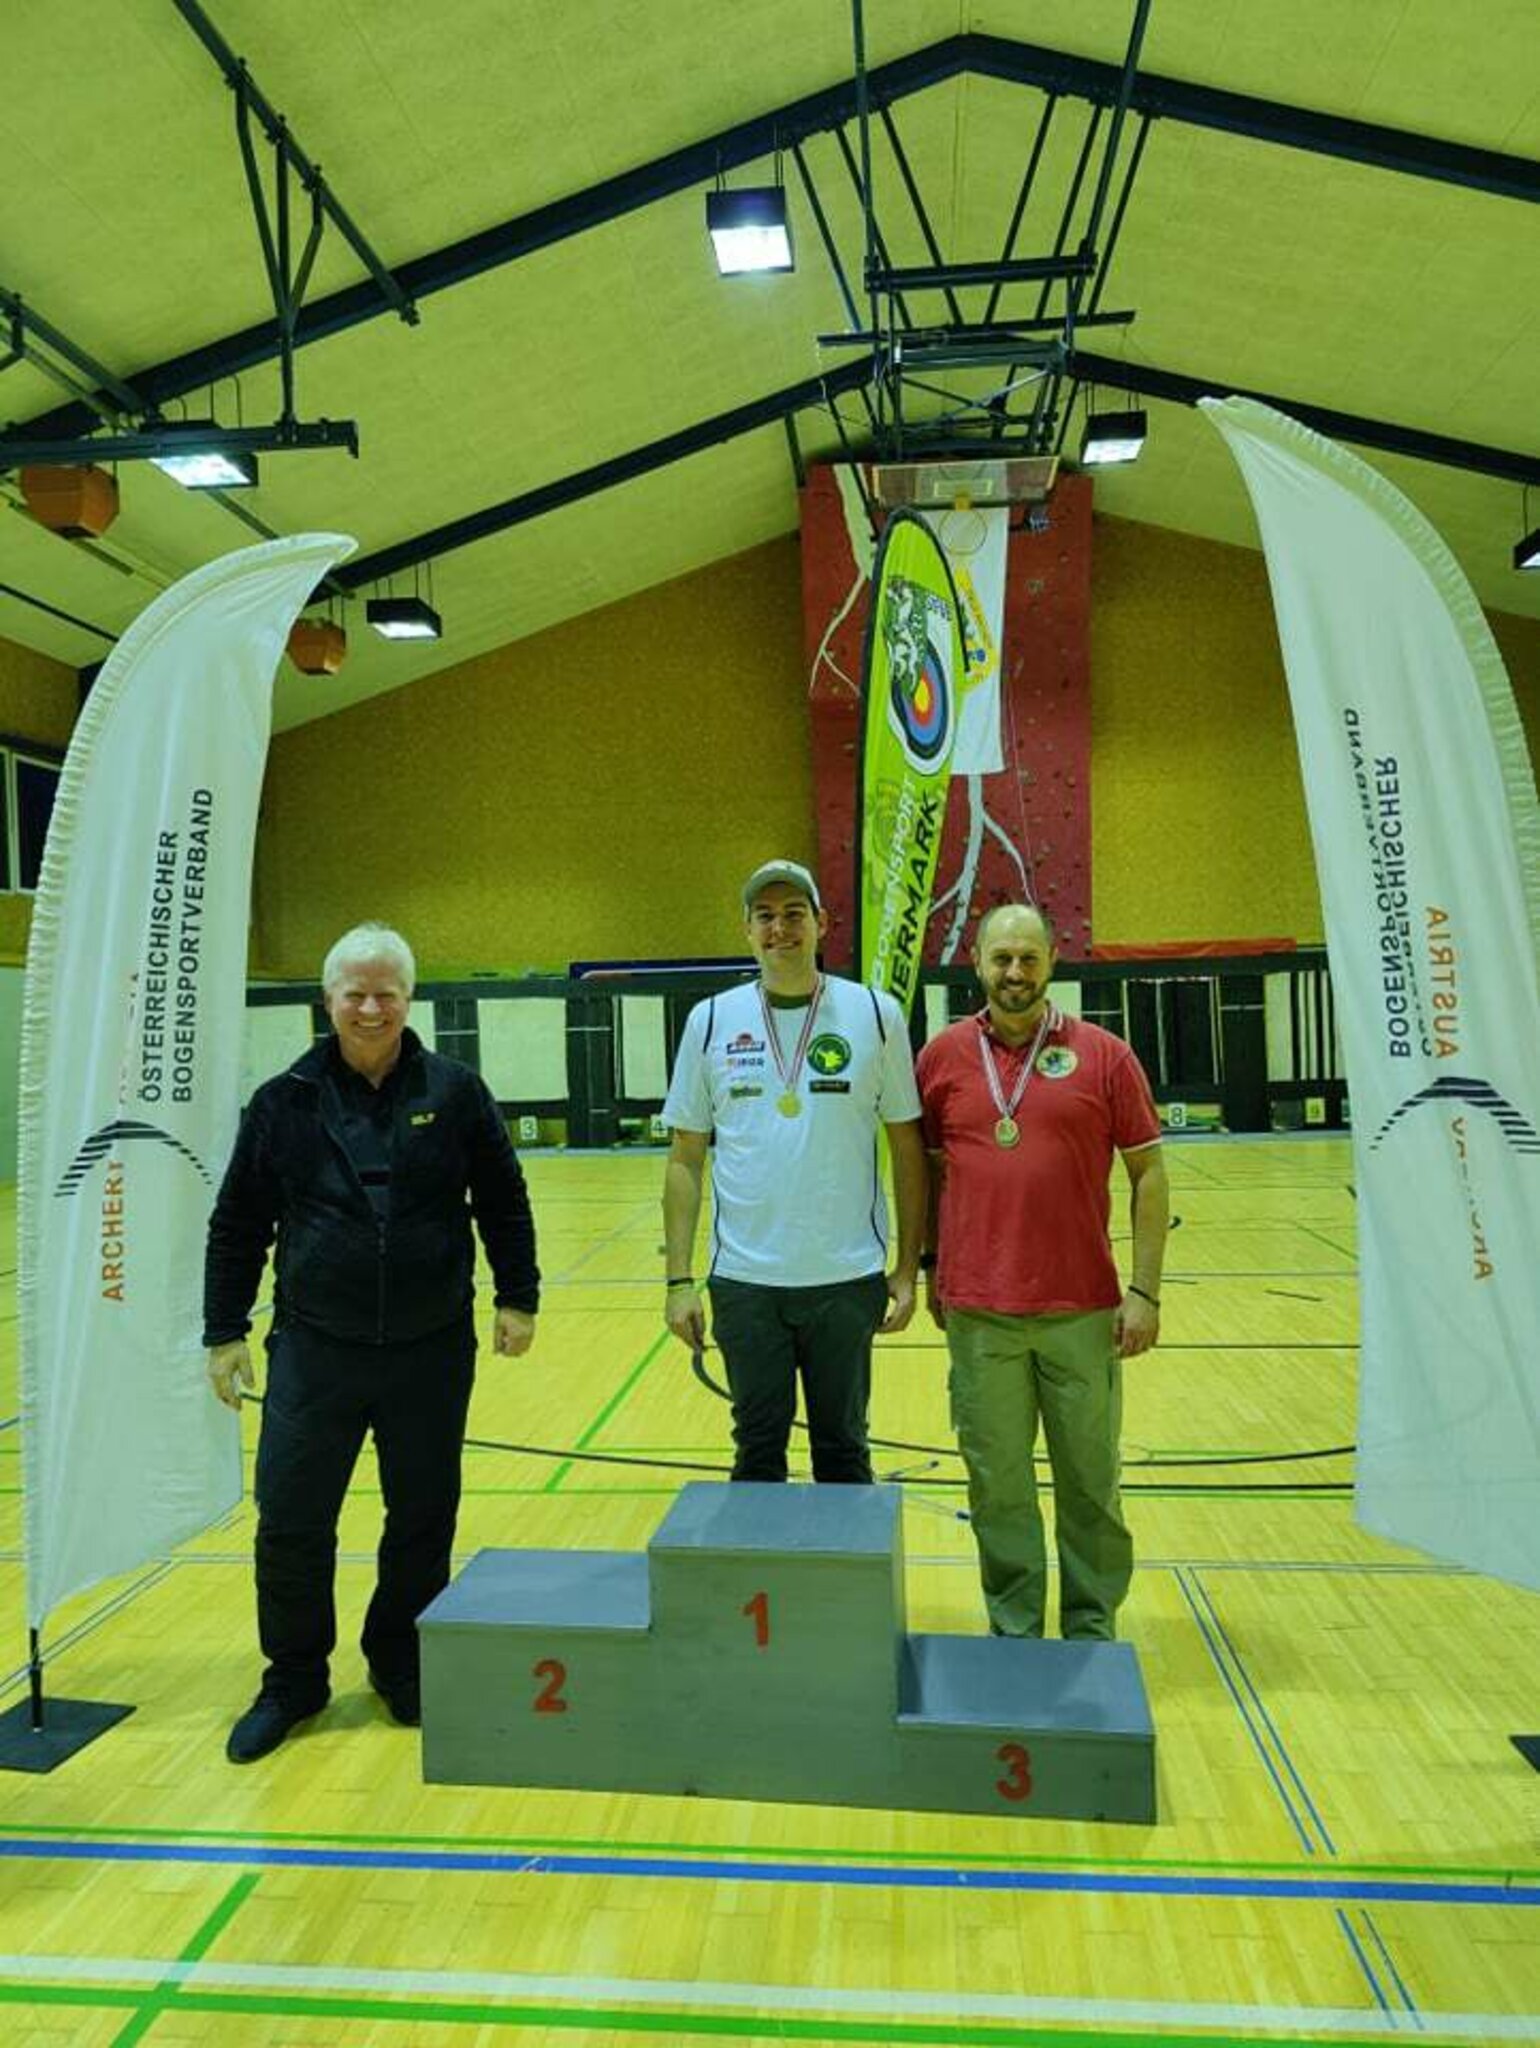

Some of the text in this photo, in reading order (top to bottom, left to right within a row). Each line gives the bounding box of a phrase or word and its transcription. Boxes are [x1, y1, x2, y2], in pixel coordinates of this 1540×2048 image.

[138, 830, 178, 1103] ÖSTERREICHISCHER
[172, 788, 213, 1103] BOGENSPORTVERBAND
[742, 1591, 770, 1648] 1
[532, 1658, 568, 1713] 2
[993, 1742, 1032, 1801] 3
